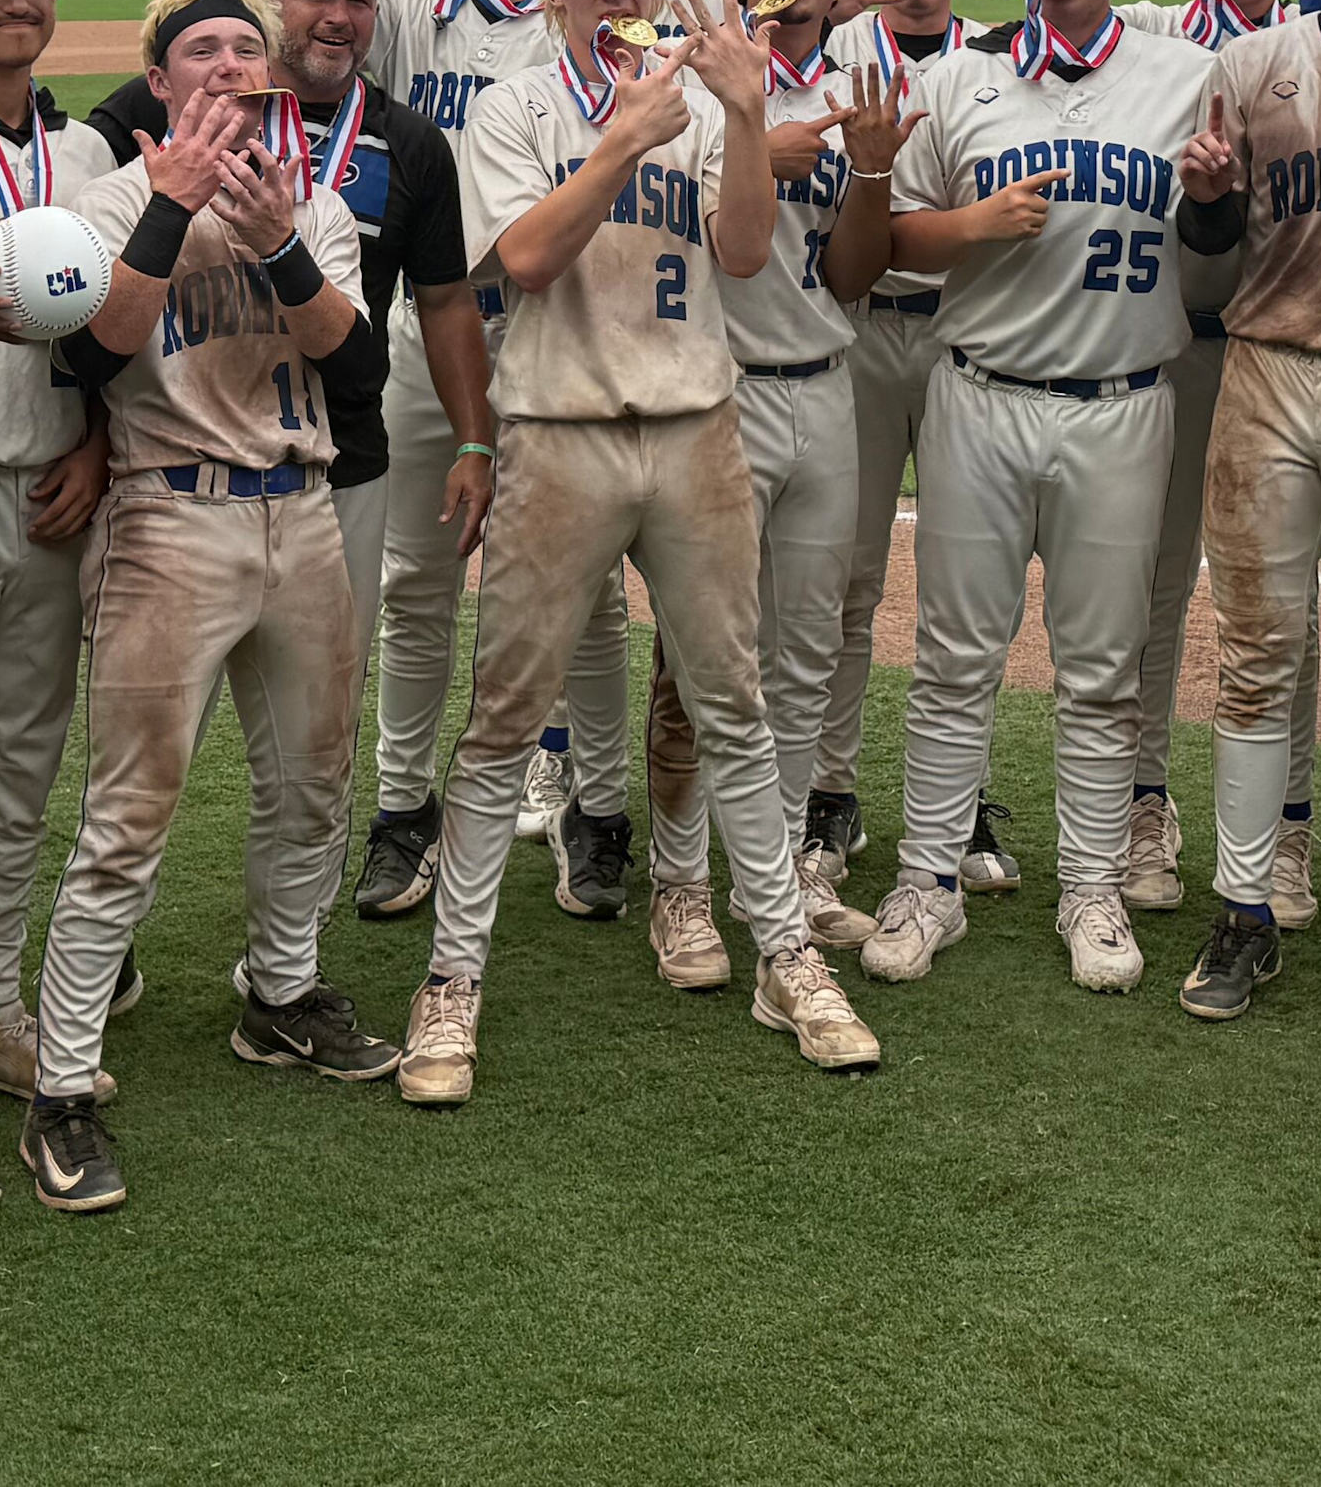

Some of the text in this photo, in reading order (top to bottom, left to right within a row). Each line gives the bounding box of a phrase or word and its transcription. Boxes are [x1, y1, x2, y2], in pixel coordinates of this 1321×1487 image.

[975, 139, 1173, 224] ROBINSON
[655, 254, 686, 320] 2
[1082, 229, 1163, 293] 25
